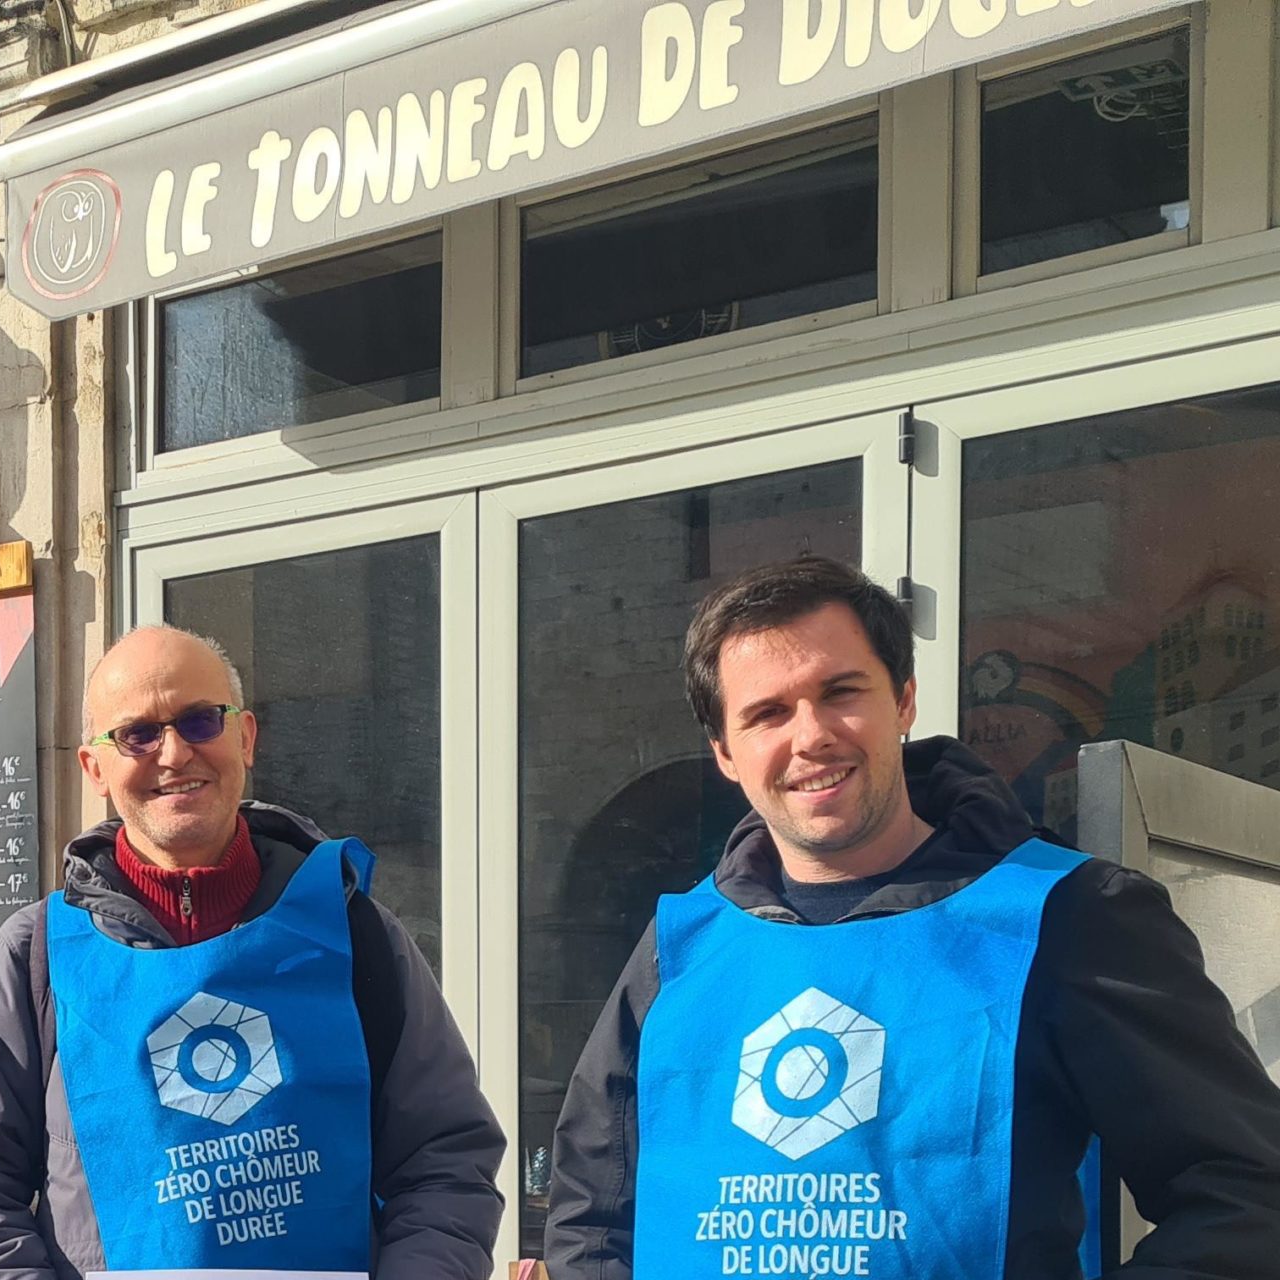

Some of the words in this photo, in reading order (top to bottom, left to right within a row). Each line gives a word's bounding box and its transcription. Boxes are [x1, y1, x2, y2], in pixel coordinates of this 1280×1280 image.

[145, 161, 221, 277] LE
[248, 46, 608, 248] TONNEAU
[637, 0, 746, 127] DE
[165, 1124, 300, 1170] TERRITOIRES
[155, 1169, 211, 1204] ZÉRO
[215, 1150, 321, 1189] CHÔMEUR
[719, 1173, 880, 1204] TERRITOIRES
[184, 1196, 217, 1224] DE
[219, 1181, 304, 1216] LONGUE
[695, 1204, 754, 1241] ZÉRO
[760, 1202, 908, 1240] CHÔMEUR
[216, 1208, 287, 1246] DURÉE
[722, 1245, 752, 1275] DE
[759, 1244, 870, 1276] LONGUE
